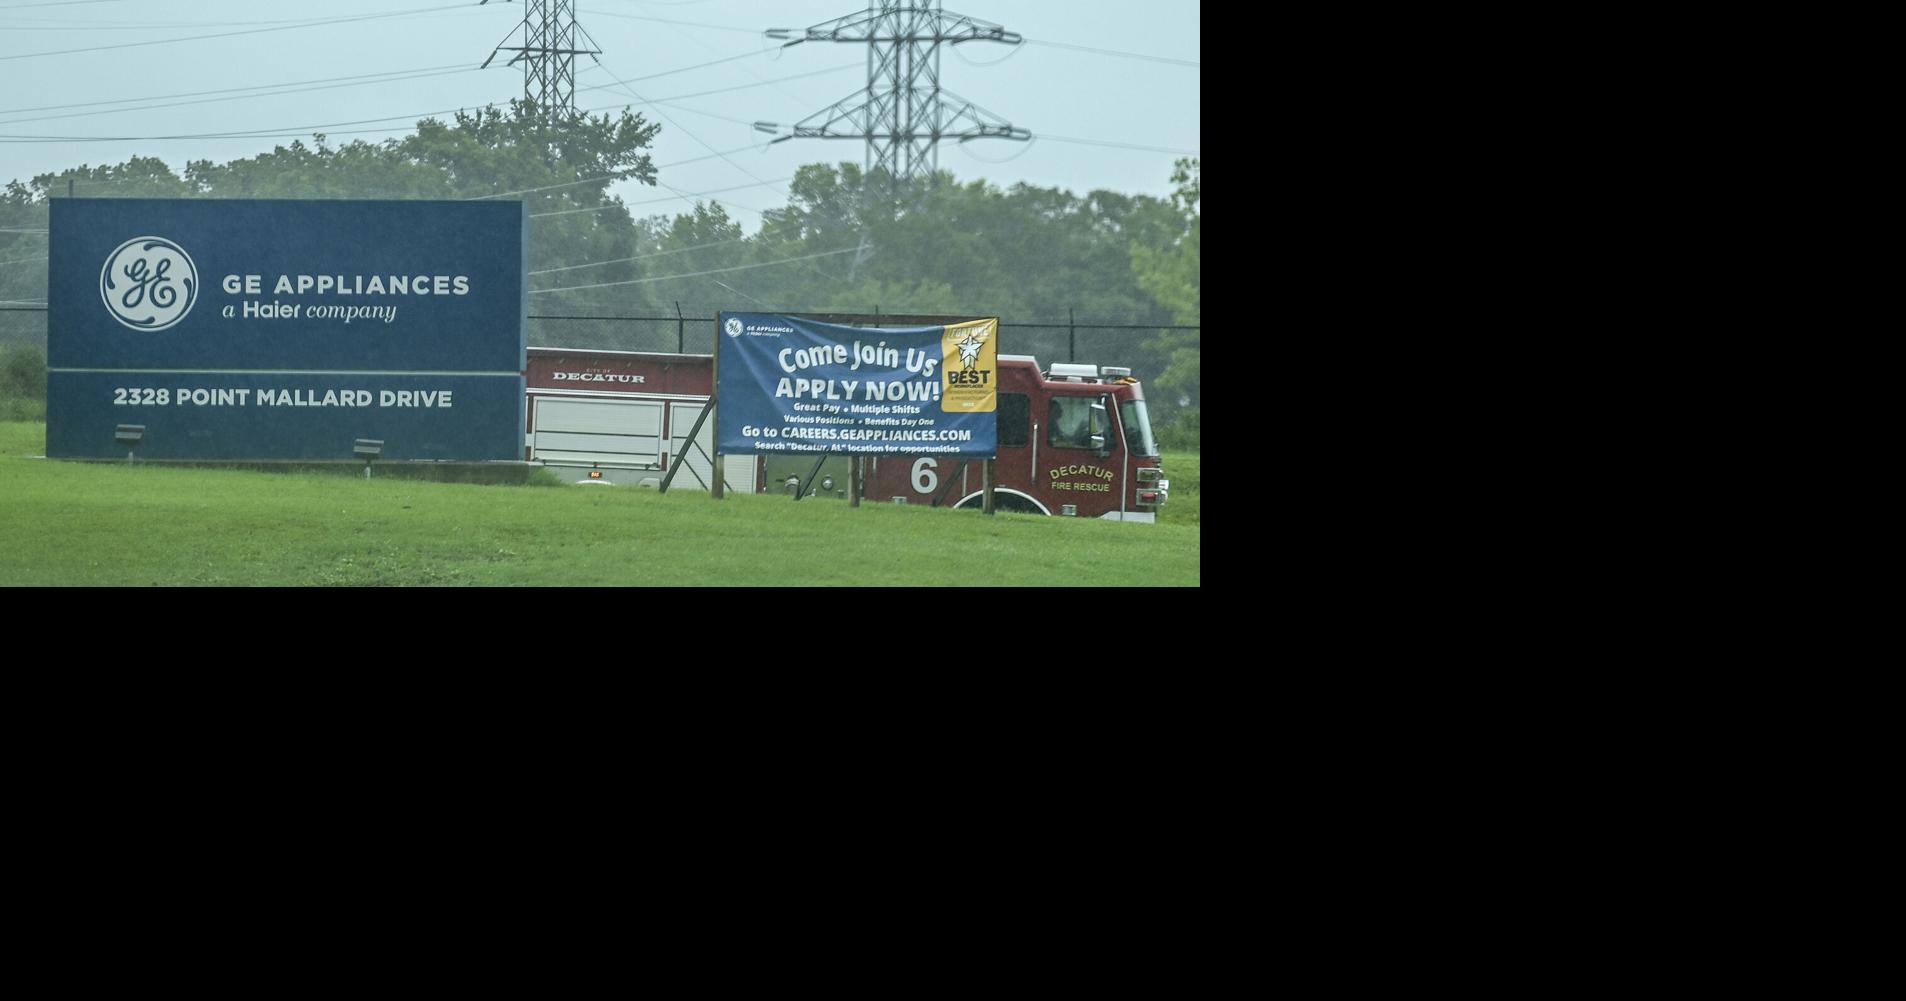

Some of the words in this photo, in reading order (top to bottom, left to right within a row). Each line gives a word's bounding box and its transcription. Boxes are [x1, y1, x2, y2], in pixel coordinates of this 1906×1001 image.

[222, 274, 262, 295] GE
[273, 274, 470, 296] APPLIANCES
[222, 303, 235, 319] a
[243, 301, 300, 320] Haier
[306, 303, 397, 323] company
[778, 344, 848, 374] Come
[850, 340, 899, 371] Join
[905, 348, 938, 378] Us
[552, 372, 645, 383] DECATUR
[947, 370, 990, 385] BEST
[775, 377, 858, 401] APPLY
[865, 381, 940, 402] NOW!
[113, 388, 170, 405] 2328
[176, 388, 250, 406] POINT
[256, 389, 373, 407] MALLARD
[379, 390, 453, 408] DRIVE
[793, 402, 821, 413] Great
[822, 403, 841, 415] Pay
[850, 404, 891, 416] Multiple
[891, 405, 921, 415] Shifts
[783, 414, 815, 424] Various
[815, 416, 855, 425] Positions
[864, 417, 900, 426] Benefits
[901, 418, 918, 428] Day
[918, 418, 935, 426] One
[742, 425, 761, 438] Go
[763, 427, 778, 438] to
[781, 427, 971, 441] CAREERS.GEAPPLIANCES.COM
[754, 441, 786, 450] Search
[847, 444, 884, 453] location
[884, 445, 899, 453] for
[900, 445, 961, 455] opportunities
[911, 457, 939, 494] 6
[1049, 464, 1114, 481] DECATUR
[1051, 481, 1071, 490] FIRE
[1073, 482, 1110, 492] RESCUE
